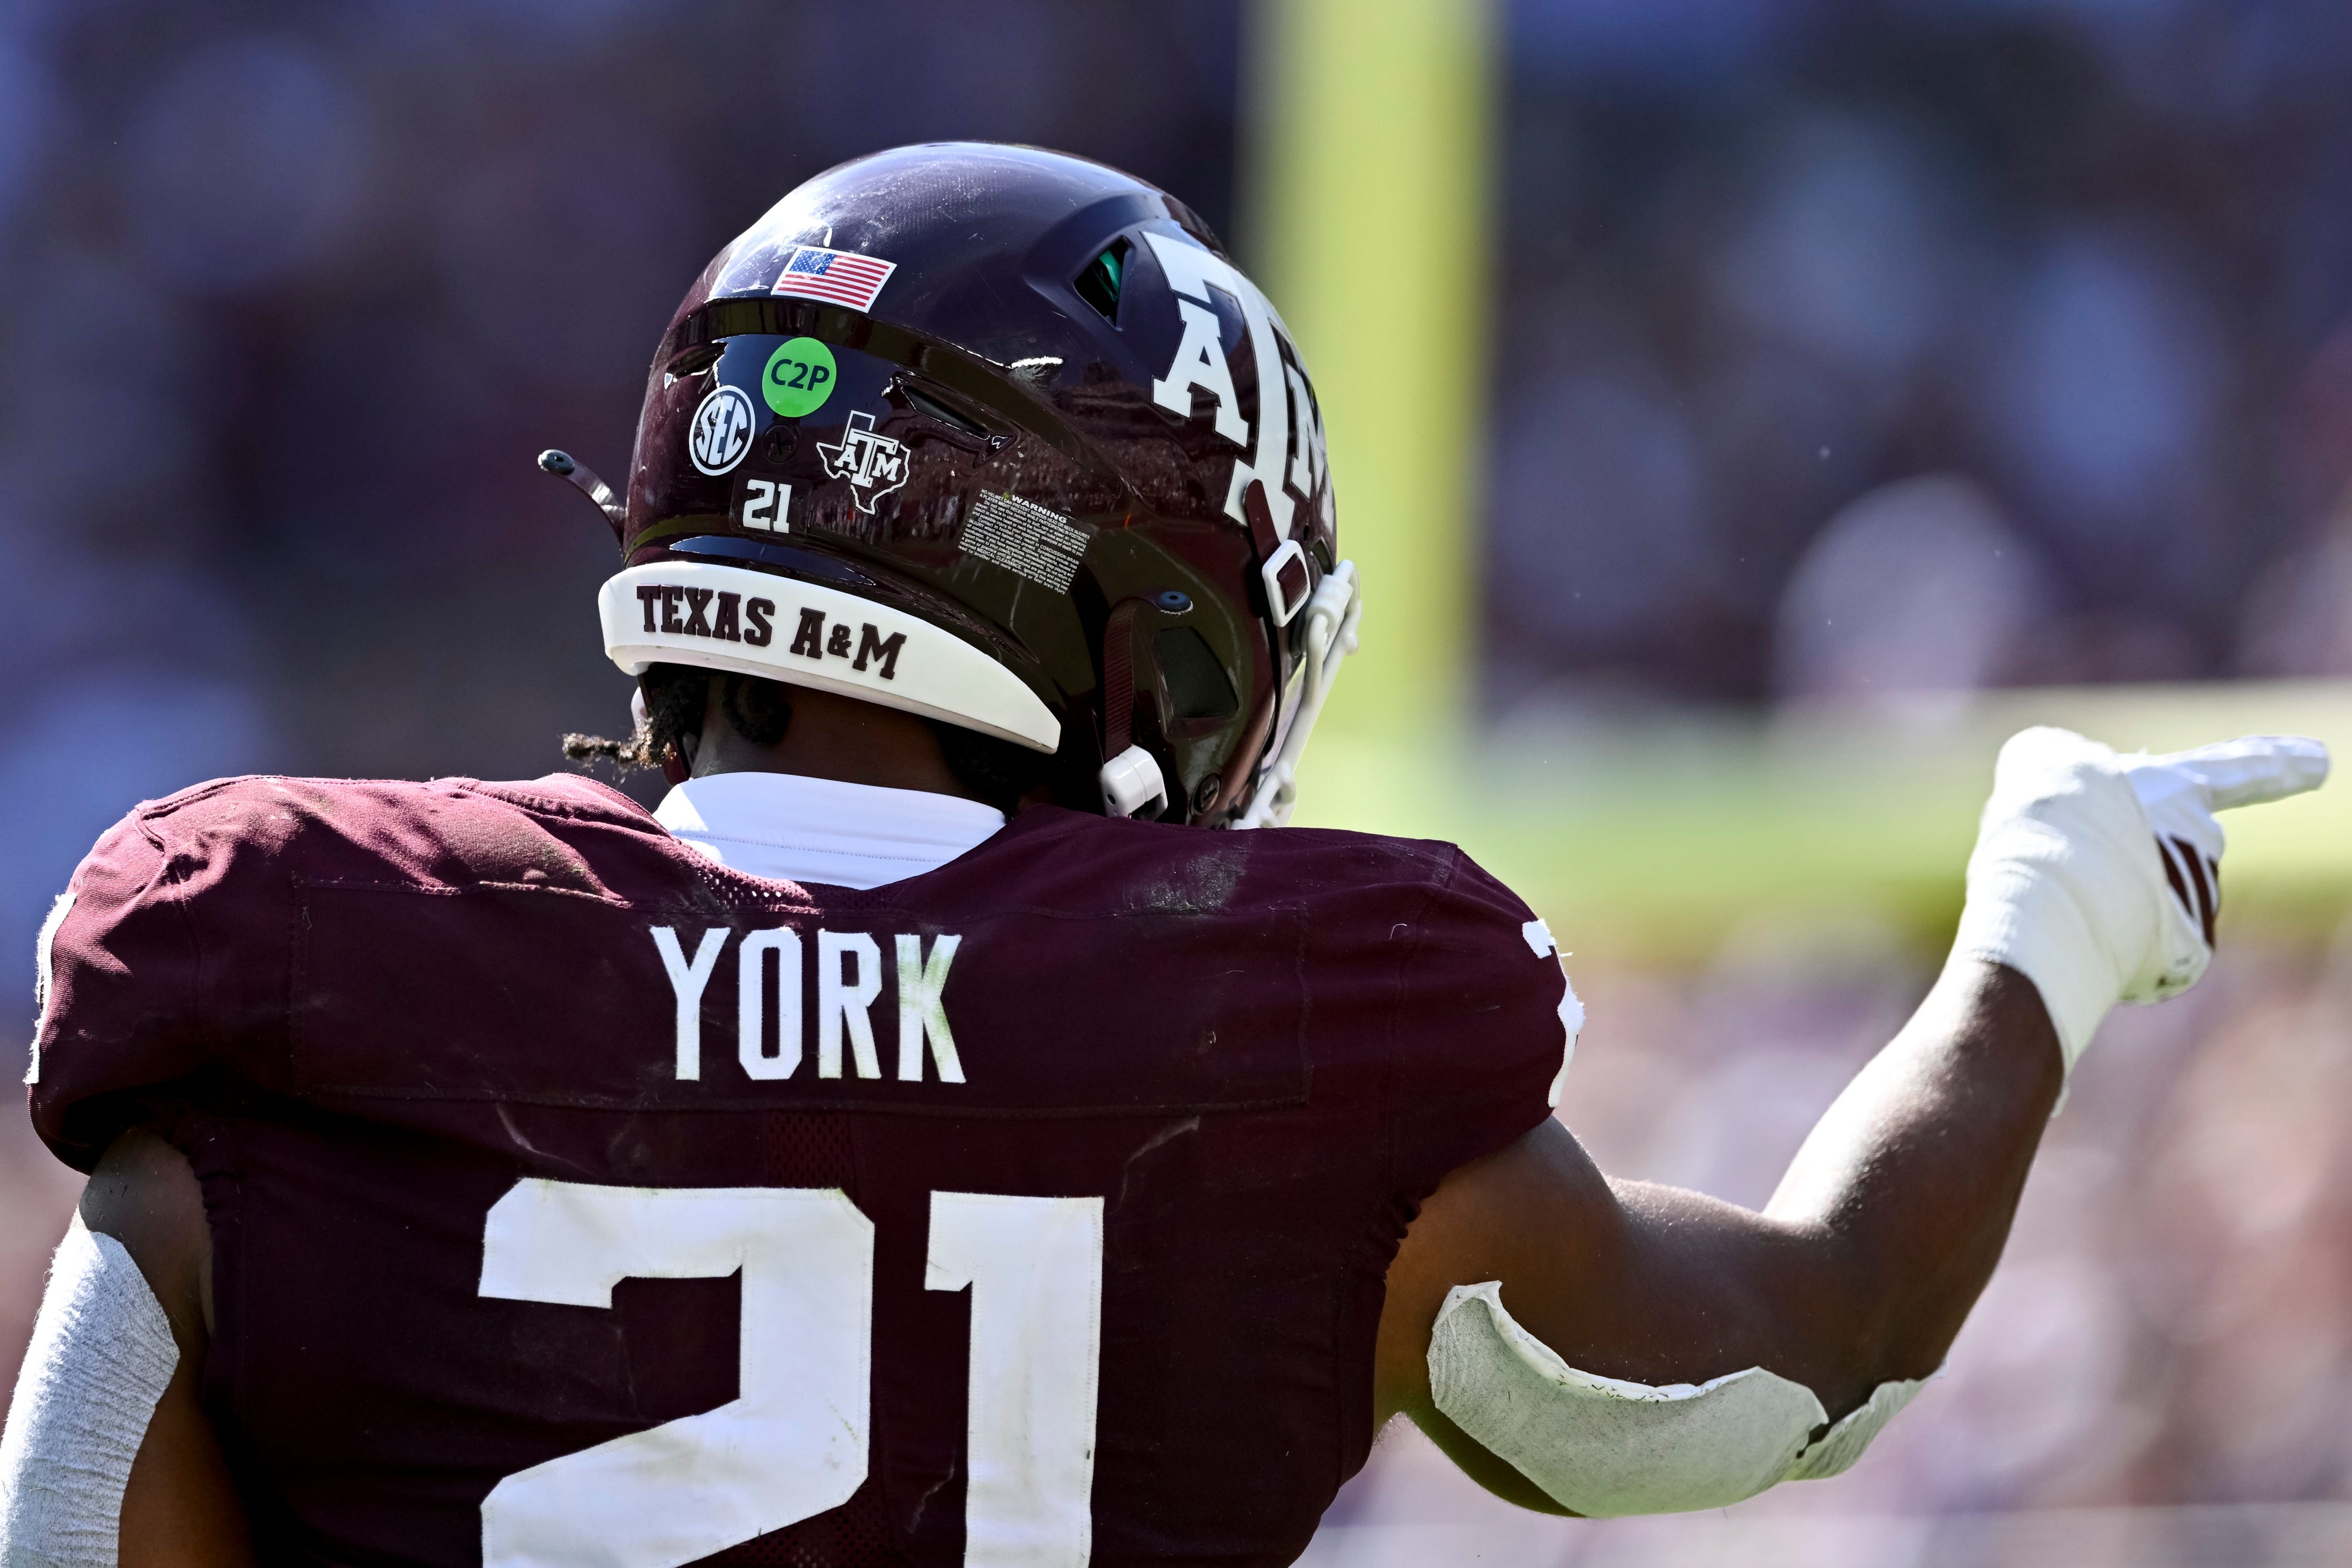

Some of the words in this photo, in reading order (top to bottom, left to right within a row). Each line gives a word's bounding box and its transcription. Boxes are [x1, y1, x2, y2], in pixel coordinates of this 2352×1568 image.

[771, 359, 830, 392] C2P
[696, 394, 747, 465] SEC
[743, 479, 792, 534] 21
[968, 519, 984, 528] INJURY
[983, 494, 998, 503] PLAYER
[1010, 506, 1027, 516] RECEIVE
[1027, 513, 1039, 521] WHILE
[1038, 519, 1065, 533] PARTICIPATING
[987, 492, 1004, 501] HELMET
[1012, 502, 1030, 512] PREVENT
[1030, 510, 1047, 520] SERIOUS
[1074, 530, 1090, 539] INJURIES
[1012, 495, 1067, 523] WARNING
[977, 547, 995, 558] MEDICAL
[1040, 544, 1079, 564] CONCUSSION-BRAIN
[636, 584, 776, 647] TEXAS
[790, 607, 907, 680] A&M
[649, 925, 967, 1084] YORK
[478, 1176, 1105, 1568] 21
